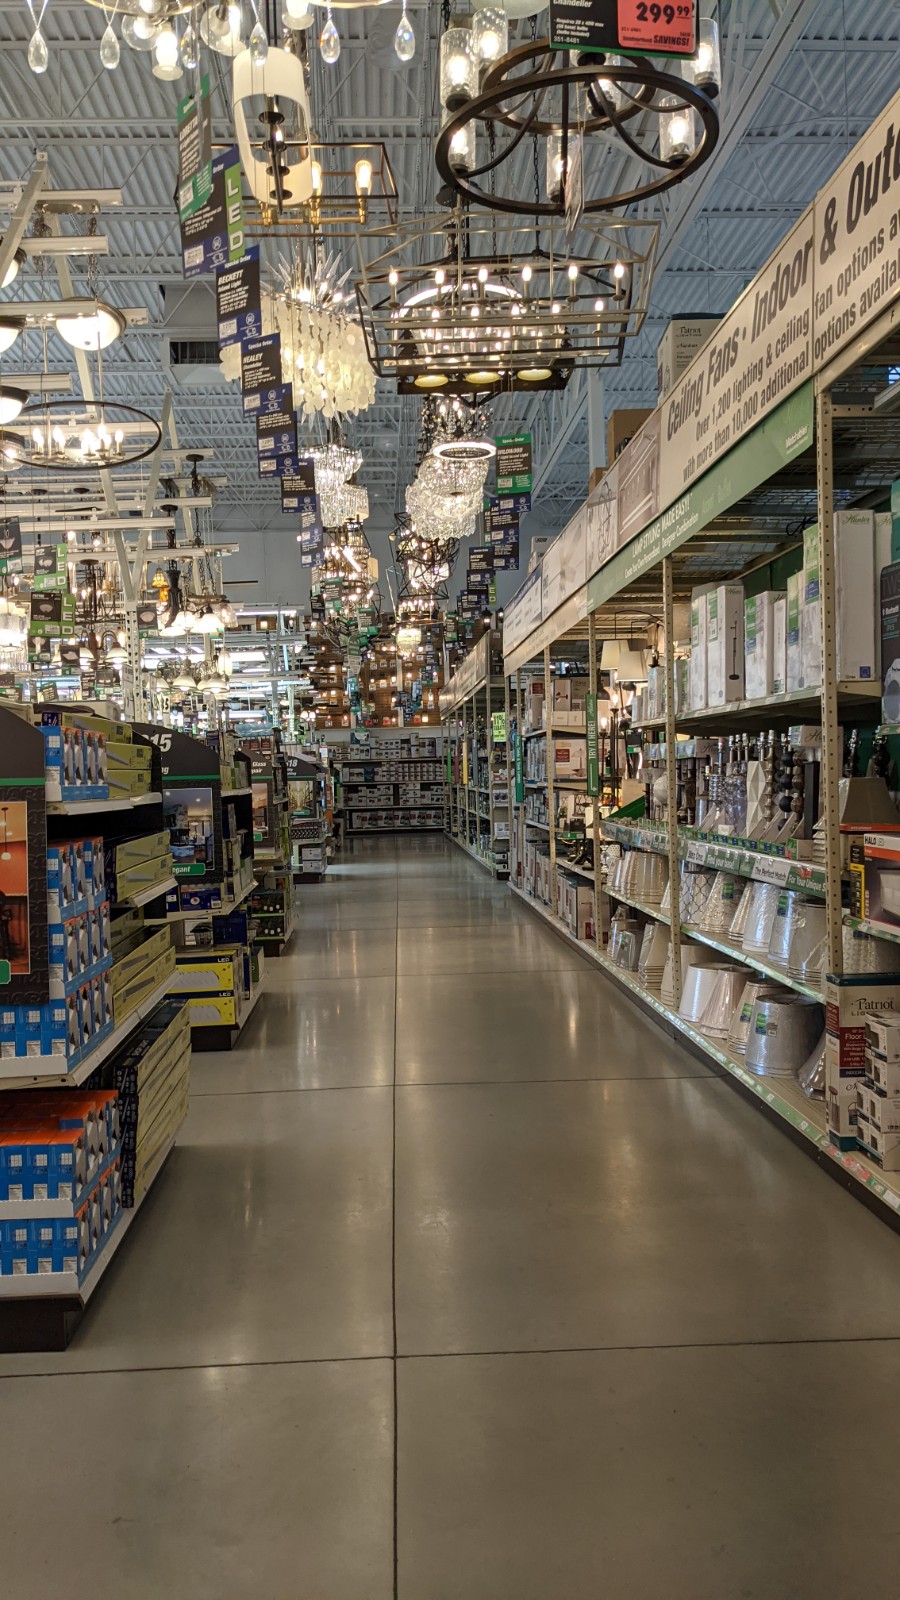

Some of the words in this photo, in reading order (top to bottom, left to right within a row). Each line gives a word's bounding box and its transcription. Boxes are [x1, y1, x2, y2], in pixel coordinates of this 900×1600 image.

[636, 2, 675, 24] 299
[653, 34, 689, 46] SAVINGS!
[218, 269, 244, 286] BECKETT
[667, 370, 705, 442] Ceiling
[706, 326, 740, 396] Fans
[751, 233, 813, 345] Indoor
[820, 196, 839, 266] &
[846, 122, 900, 234] Out
[680, 326, 702, 334] Patriot
[695, 414, 711, 442] Over
[712, 387, 732, 427] 1,200
[732, 356, 764, 404] lighting
[766, 342, 773, 369] &
[775, 307, 810, 359] ceiling
[814, 283, 834, 321] fan
[836, 227, 885, 297] options
[683, 455, 696, 483] with
[697, 441, 713, 470] more
[714, 423, 730, 454] than
[732, 390, 759, 435] 10,000
[760, 341, 810, 402] additional
[814, 301, 857, 360] options
[661, 513, 676, 533] MADE
[676, 512, 699, 537] Combination
[587, 720, 596, 740] HERE!
[588, 746, 597, 760] TRY
[864, 836, 877, 845] HALO
[761, 867, 775, 879] Perfect
[774, 870, 787, 881] Match
[788, 874, 796, 883] For
[796, 876, 806, 887] Your
[805, 878, 822, 890] Unique
[855, 997, 895, 1011] Patriot
